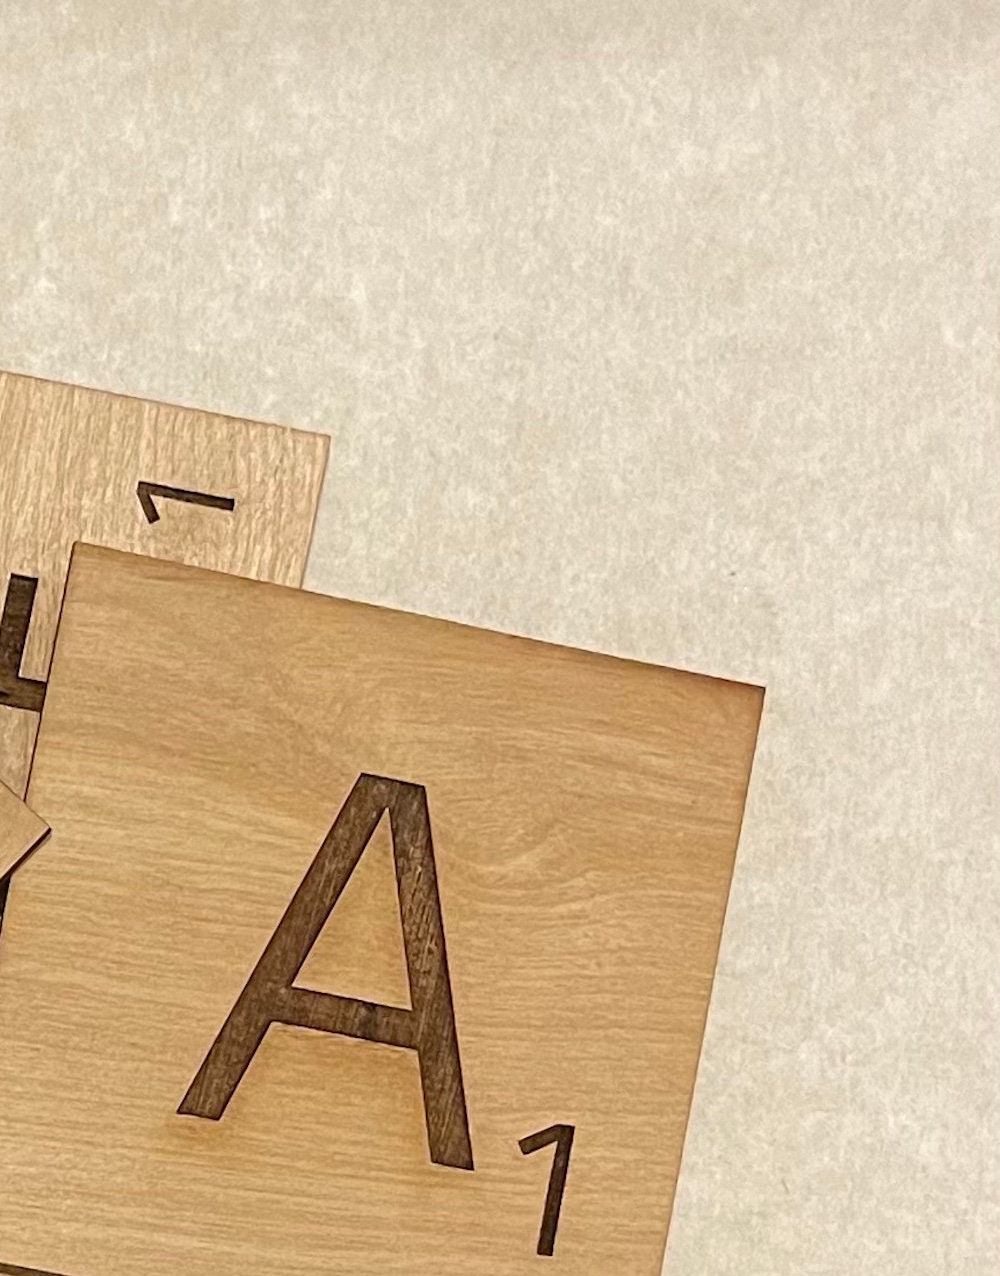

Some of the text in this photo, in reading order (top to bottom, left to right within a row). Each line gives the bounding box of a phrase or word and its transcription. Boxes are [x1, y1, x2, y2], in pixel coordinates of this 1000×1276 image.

[136, 481, 235, 525] 1
[176, 773, 576, 1257] A 1
